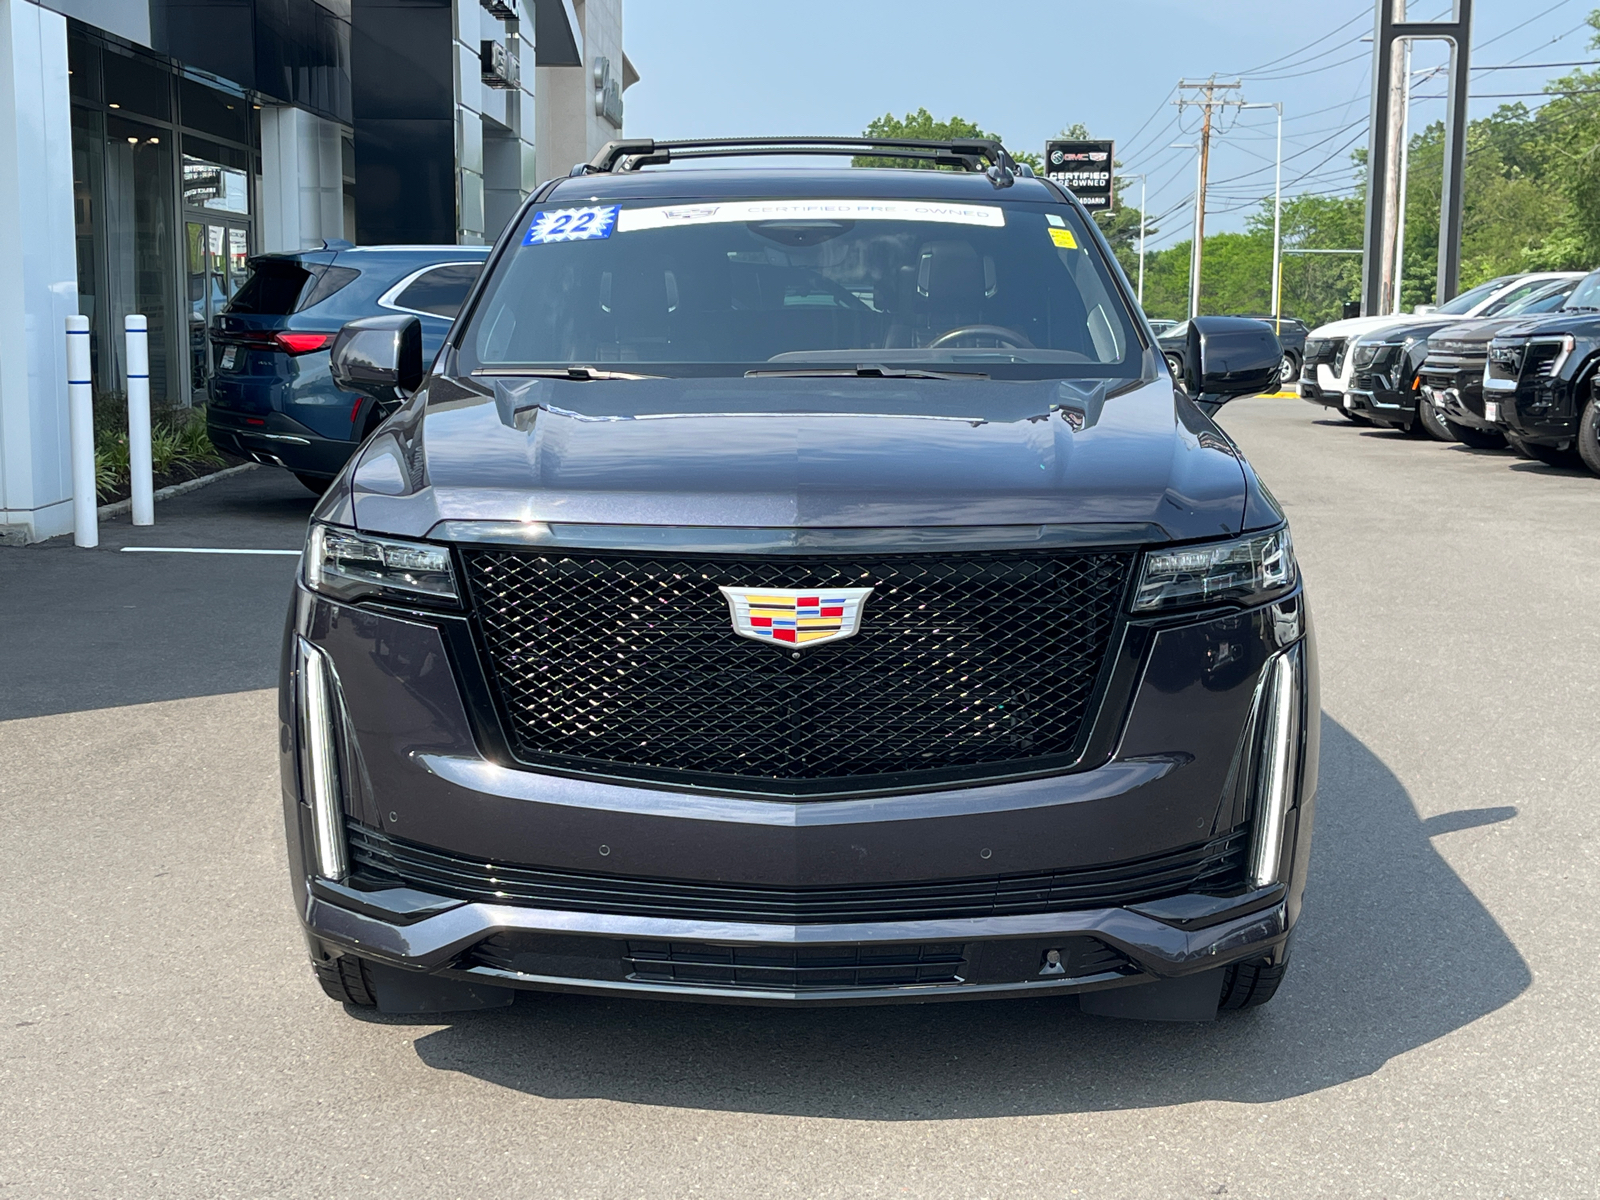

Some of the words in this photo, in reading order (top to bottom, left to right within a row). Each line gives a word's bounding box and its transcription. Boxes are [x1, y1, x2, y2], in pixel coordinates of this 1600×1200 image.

[1064, 153, 1089, 161] GMC
[1049, 172, 1109, 180] CERTIFIED
[915, 207, 990, 218] OWNED
[547, 212, 596, 235] 22
